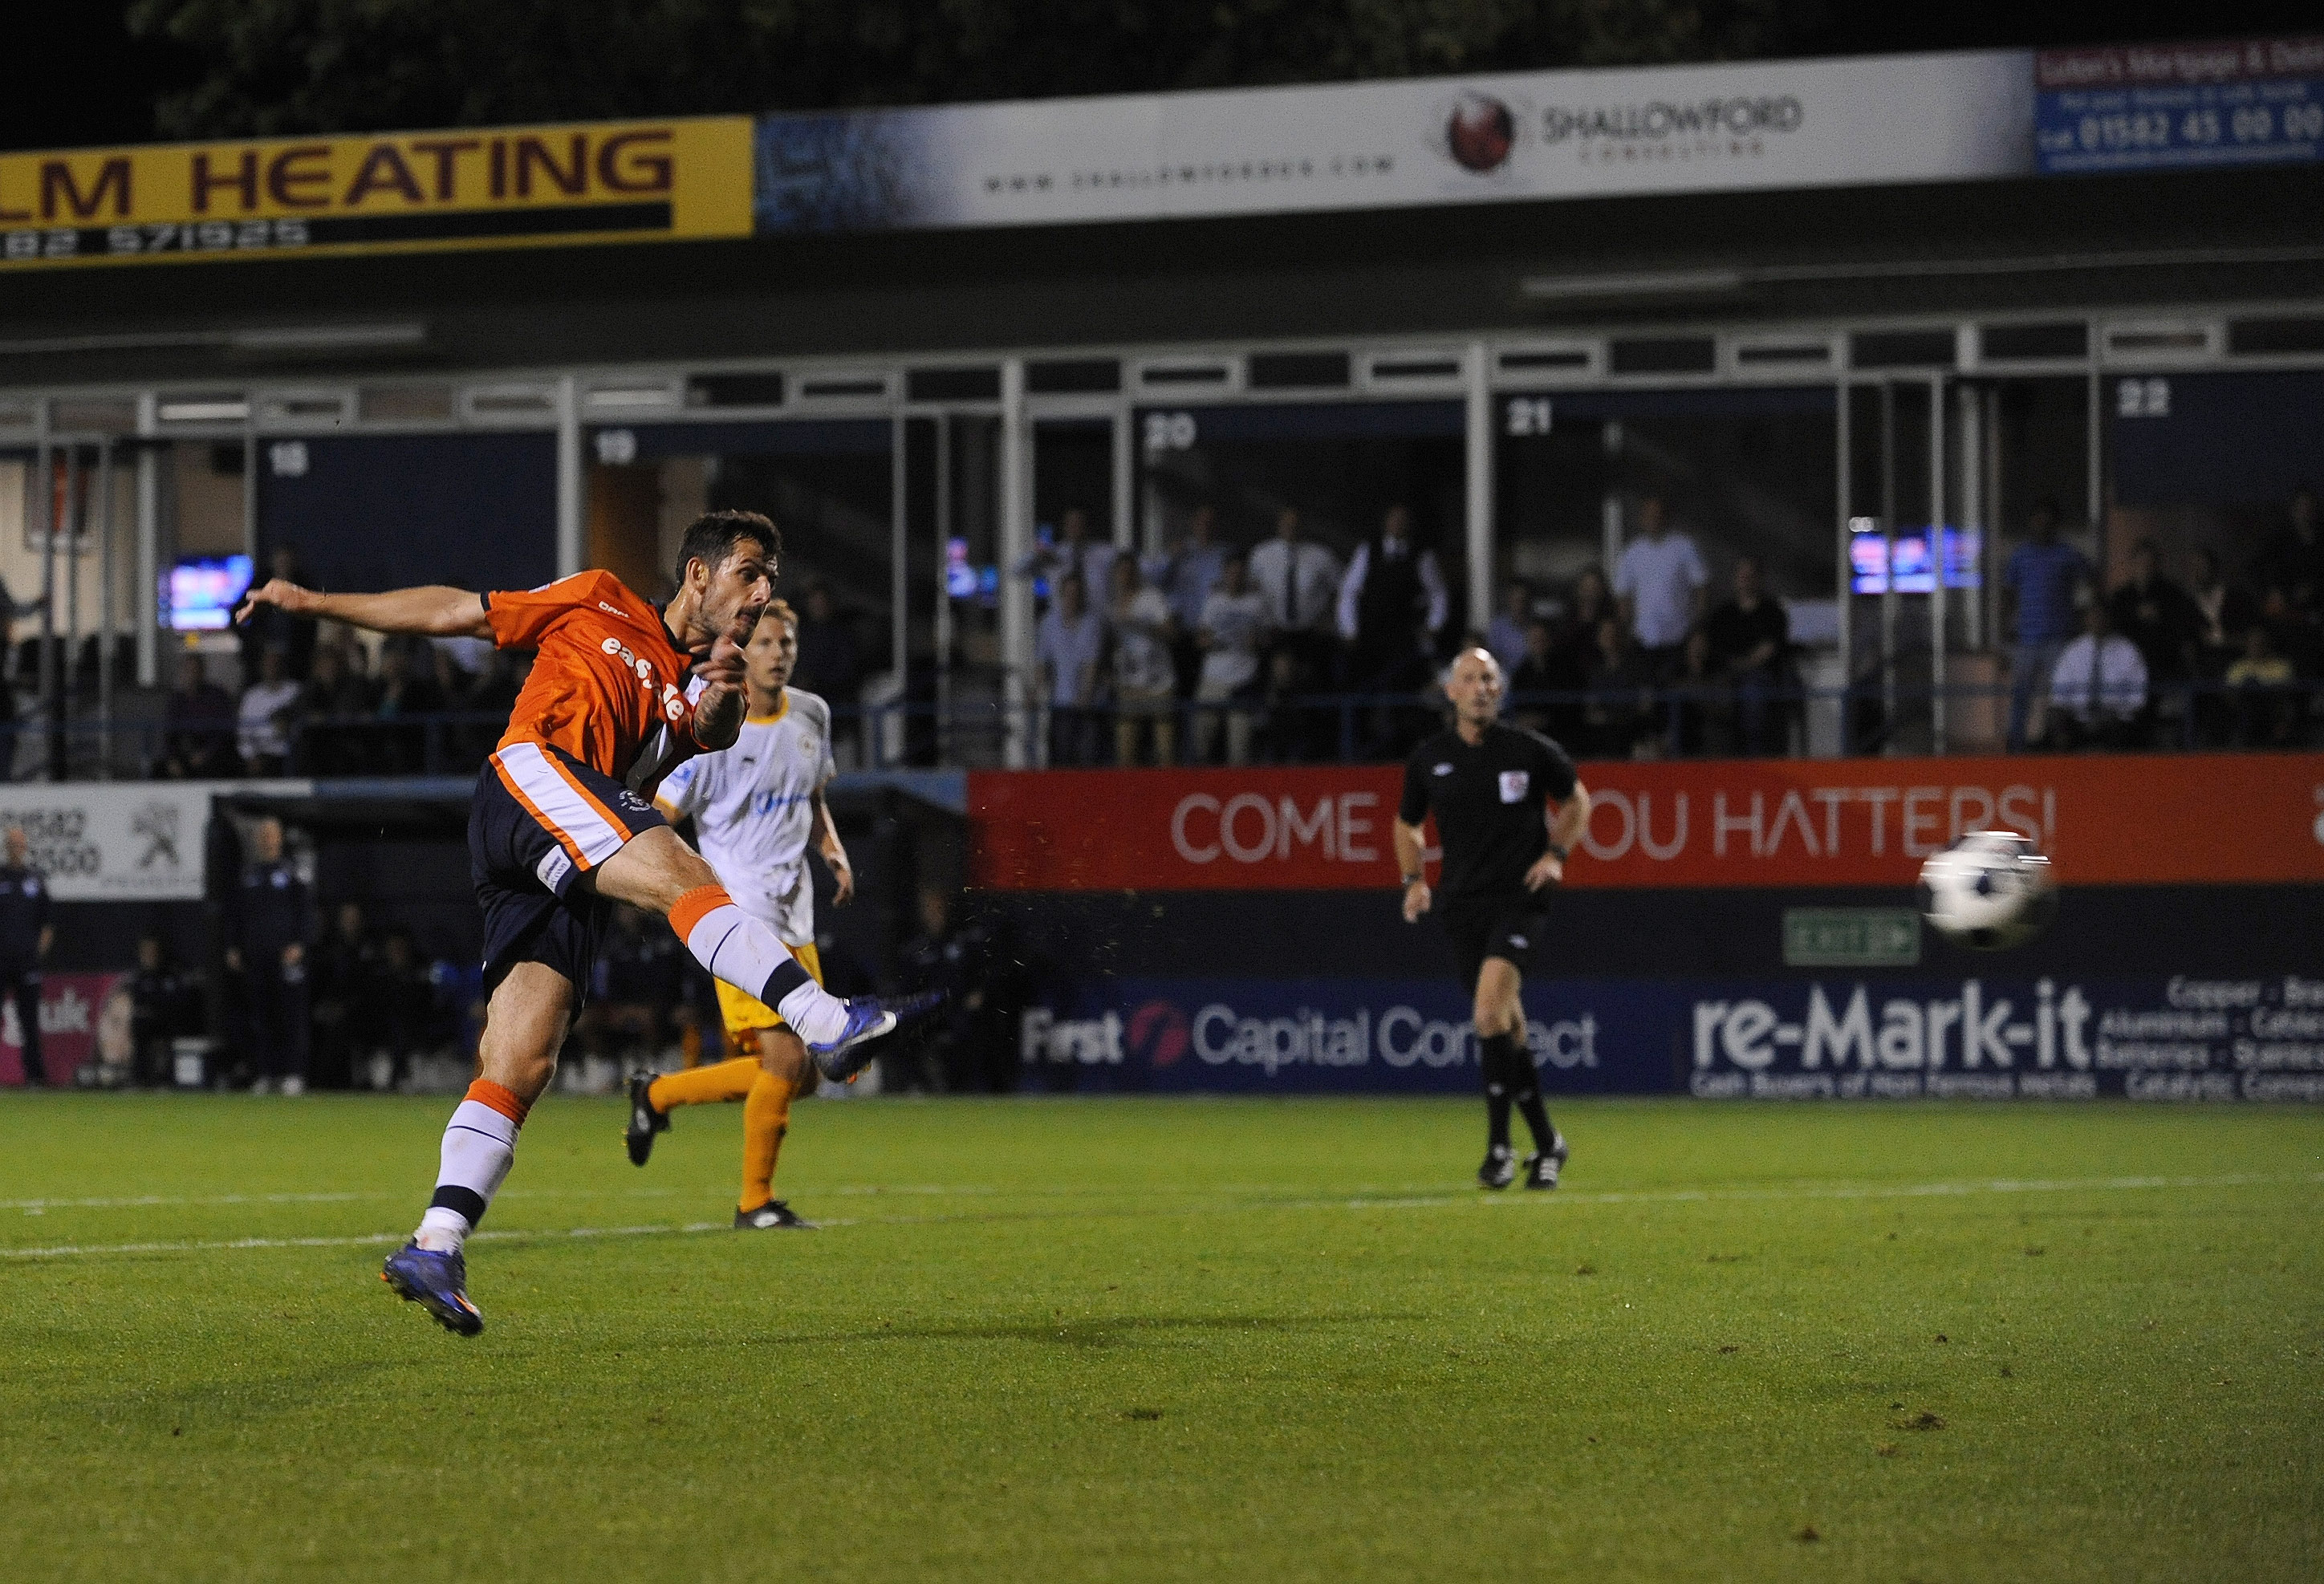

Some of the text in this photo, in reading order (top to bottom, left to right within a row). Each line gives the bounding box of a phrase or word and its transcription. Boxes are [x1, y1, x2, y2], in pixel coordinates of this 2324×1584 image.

[2231, 104, 2273, 143] 00
[191, 128, 674, 212] HEATING
[2, 216, 313, 261] 82 571925
[1506, 396, 1554, 437] 21
[2115, 376, 2172, 419] 22
[1143, 412, 1198, 452] 20
[601, 637, 685, 721] easJe
[1170, 783, 2057, 865] COME OU HATTERS!
[38, 986, 90, 1034] uk
[1692, 977, 2091, 1070] re-Mark-it
[1020, 1003, 1601, 1077] First Capital Conect
